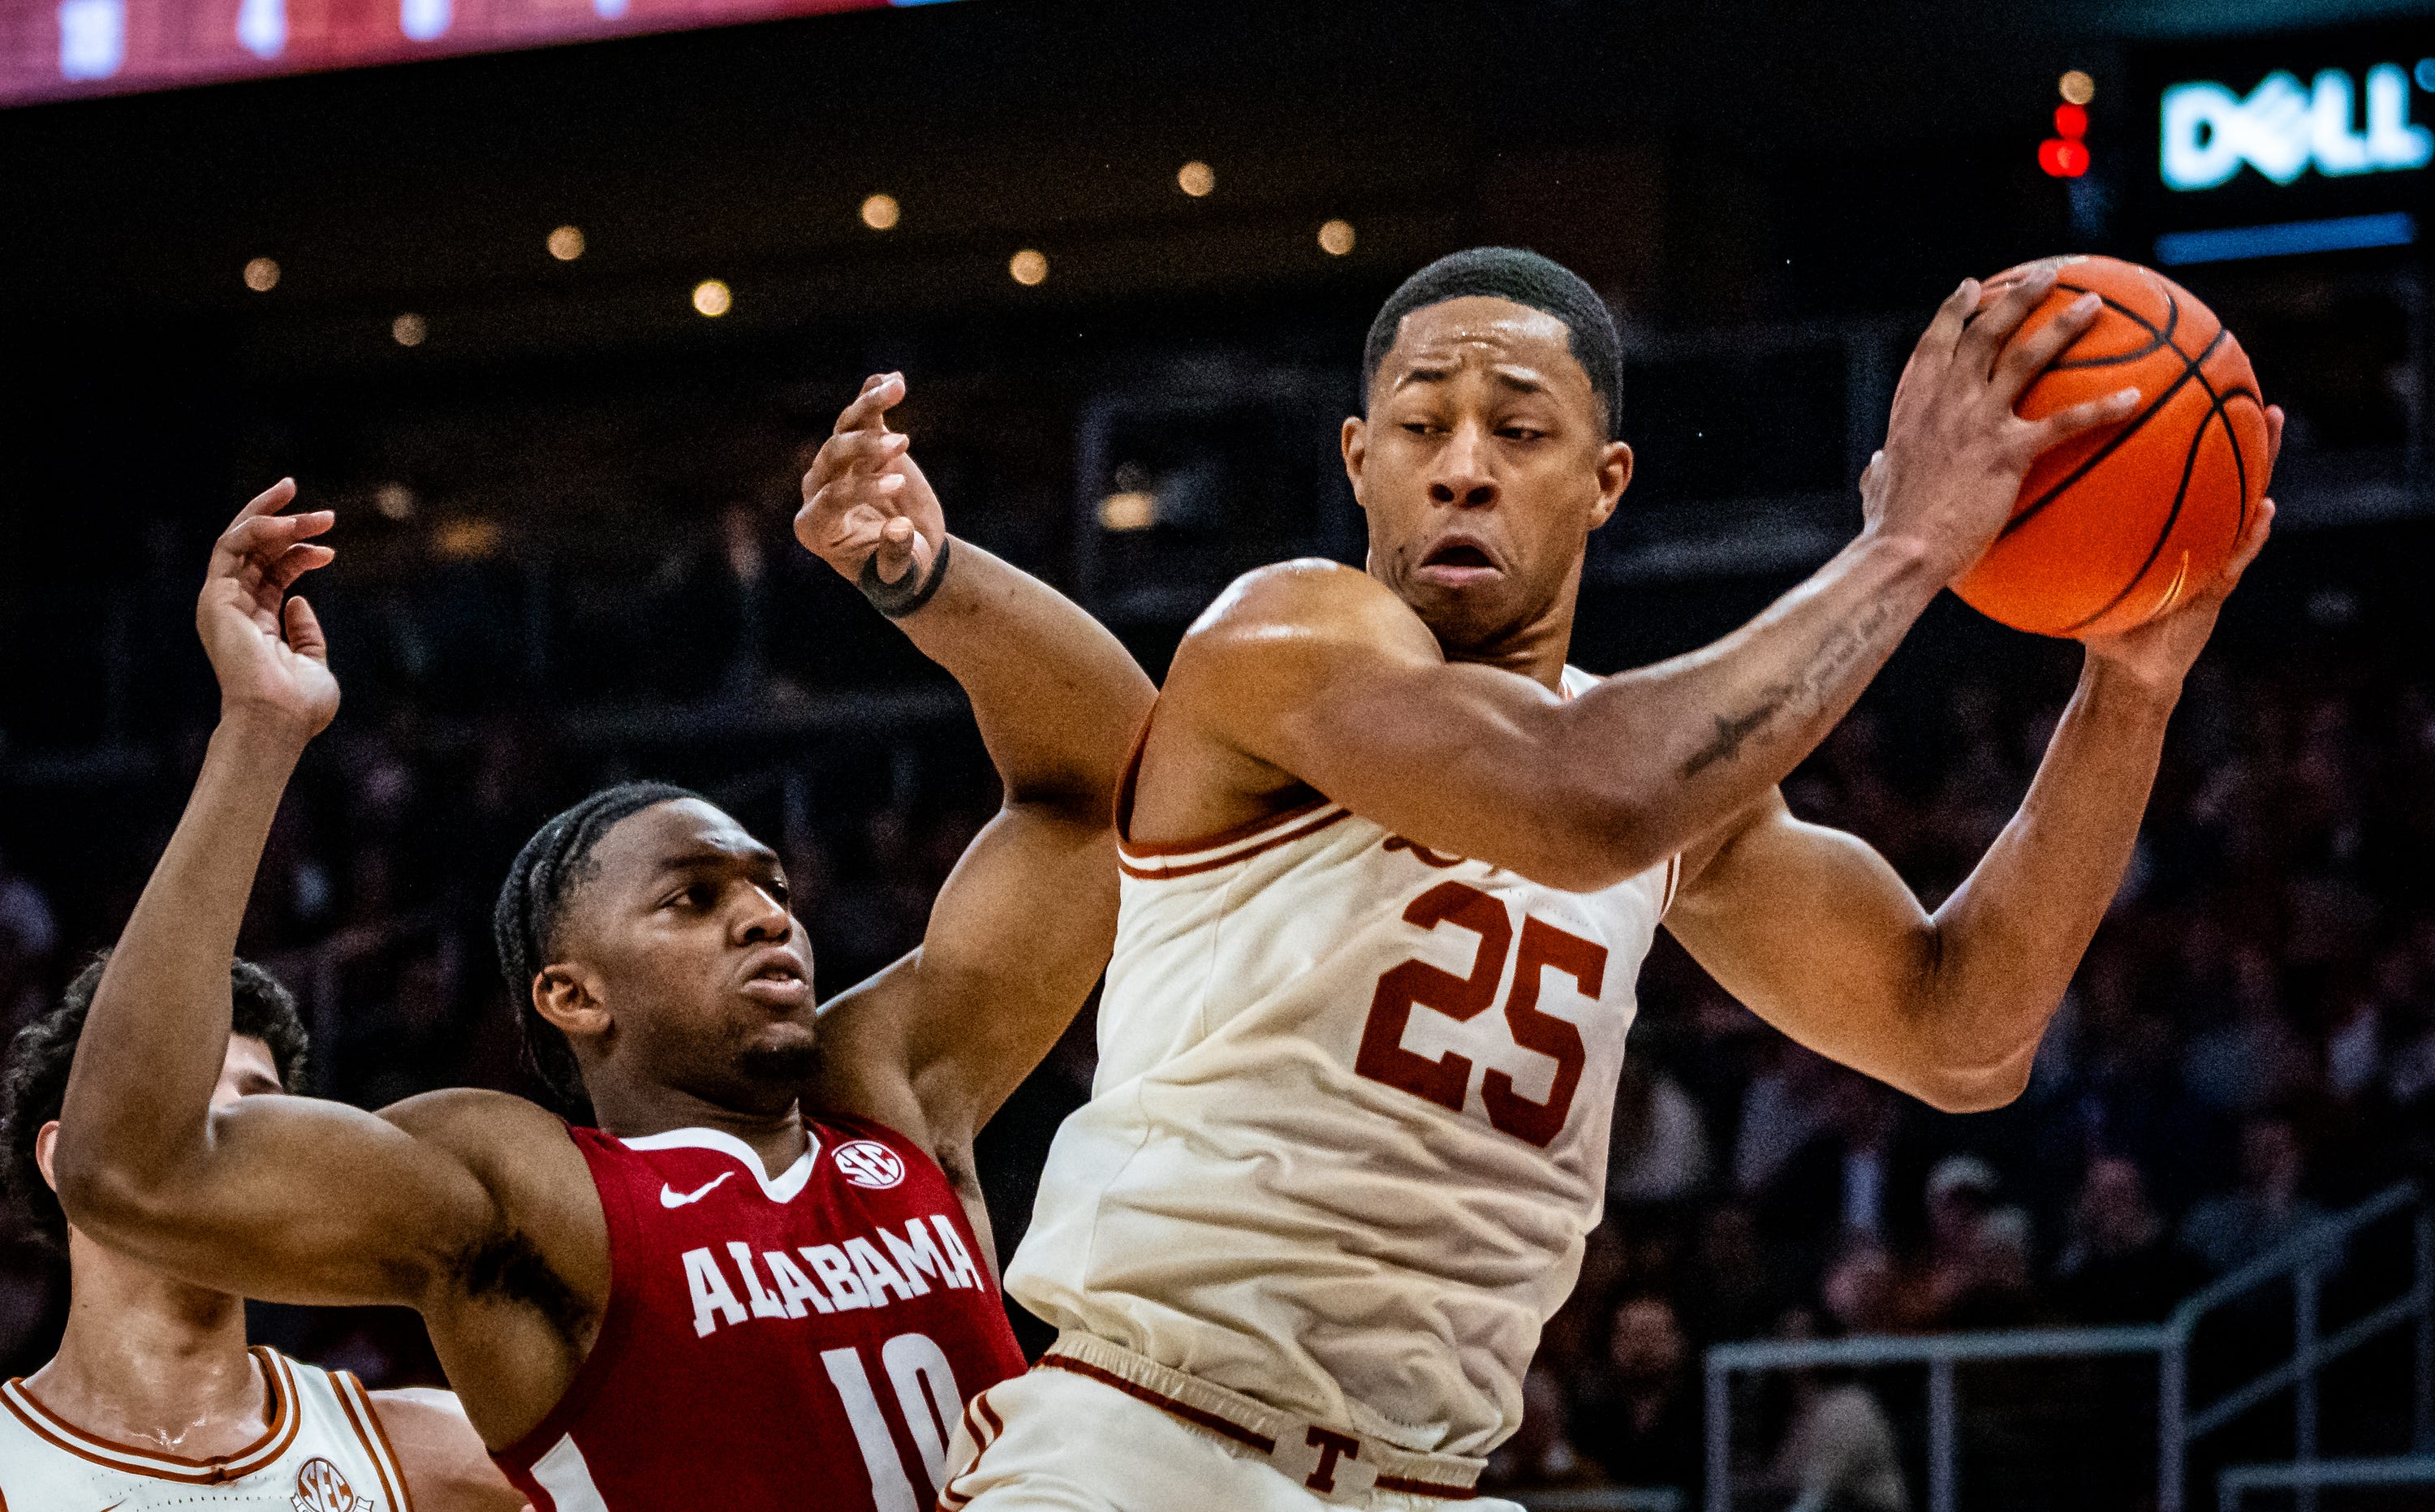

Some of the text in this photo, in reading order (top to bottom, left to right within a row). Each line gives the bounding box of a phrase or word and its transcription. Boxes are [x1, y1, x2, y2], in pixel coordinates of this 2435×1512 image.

[1355, 880, 1609, 1148] 25
[835, 1143, 900, 1185] SEC
[682, 1214, 984, 1338] ALABAMA
[300, 1461, 351, 1512] SEC
[1305, 1425, 1360, 1493] T
